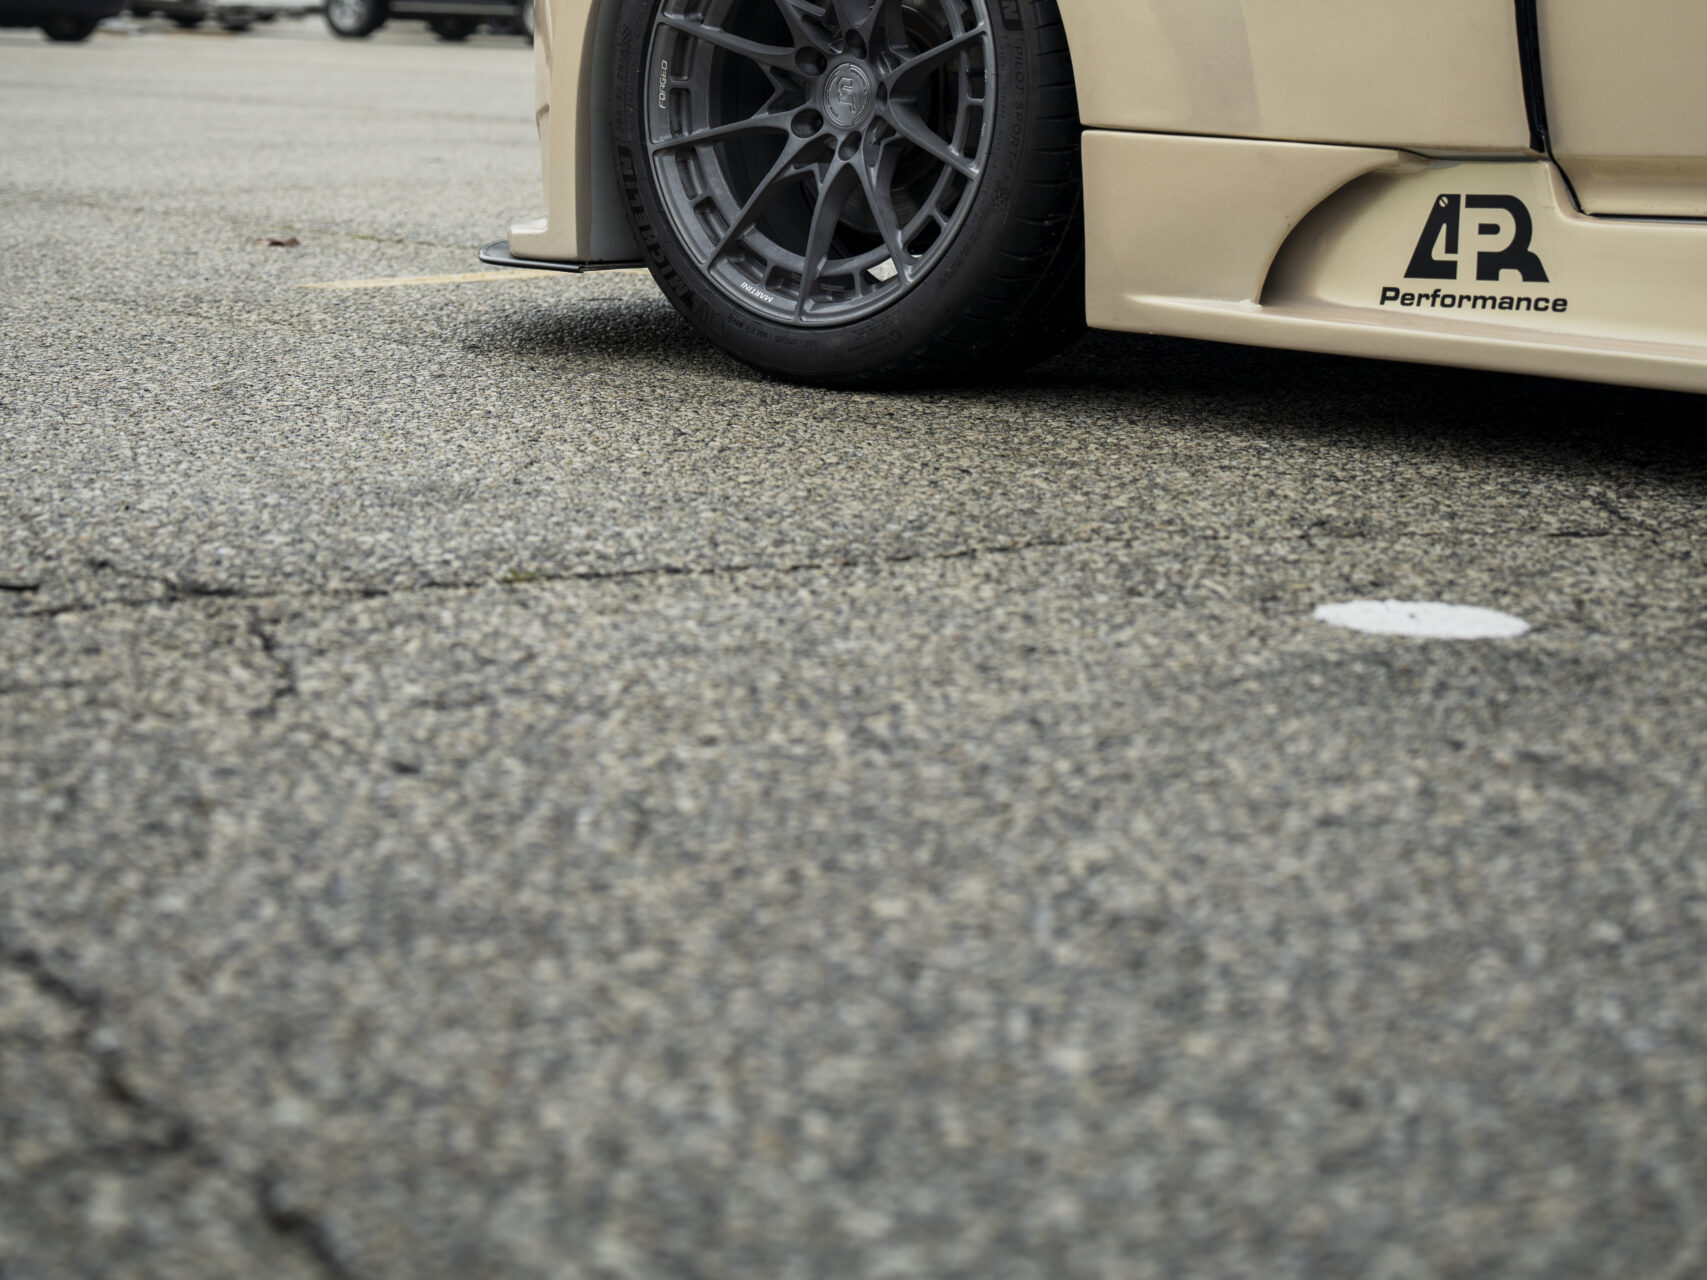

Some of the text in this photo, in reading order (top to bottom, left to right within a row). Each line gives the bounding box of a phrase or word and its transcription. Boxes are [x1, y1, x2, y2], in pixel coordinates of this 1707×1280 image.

[658, 59, 668, 110] FORGED
[1013, 45, 1025, 95] PILOT
[1008, 101, 1024, 160] SPORT
[740, 280, 774, 303] MARTINI
[1379, 286, 1569, 313] Performance
